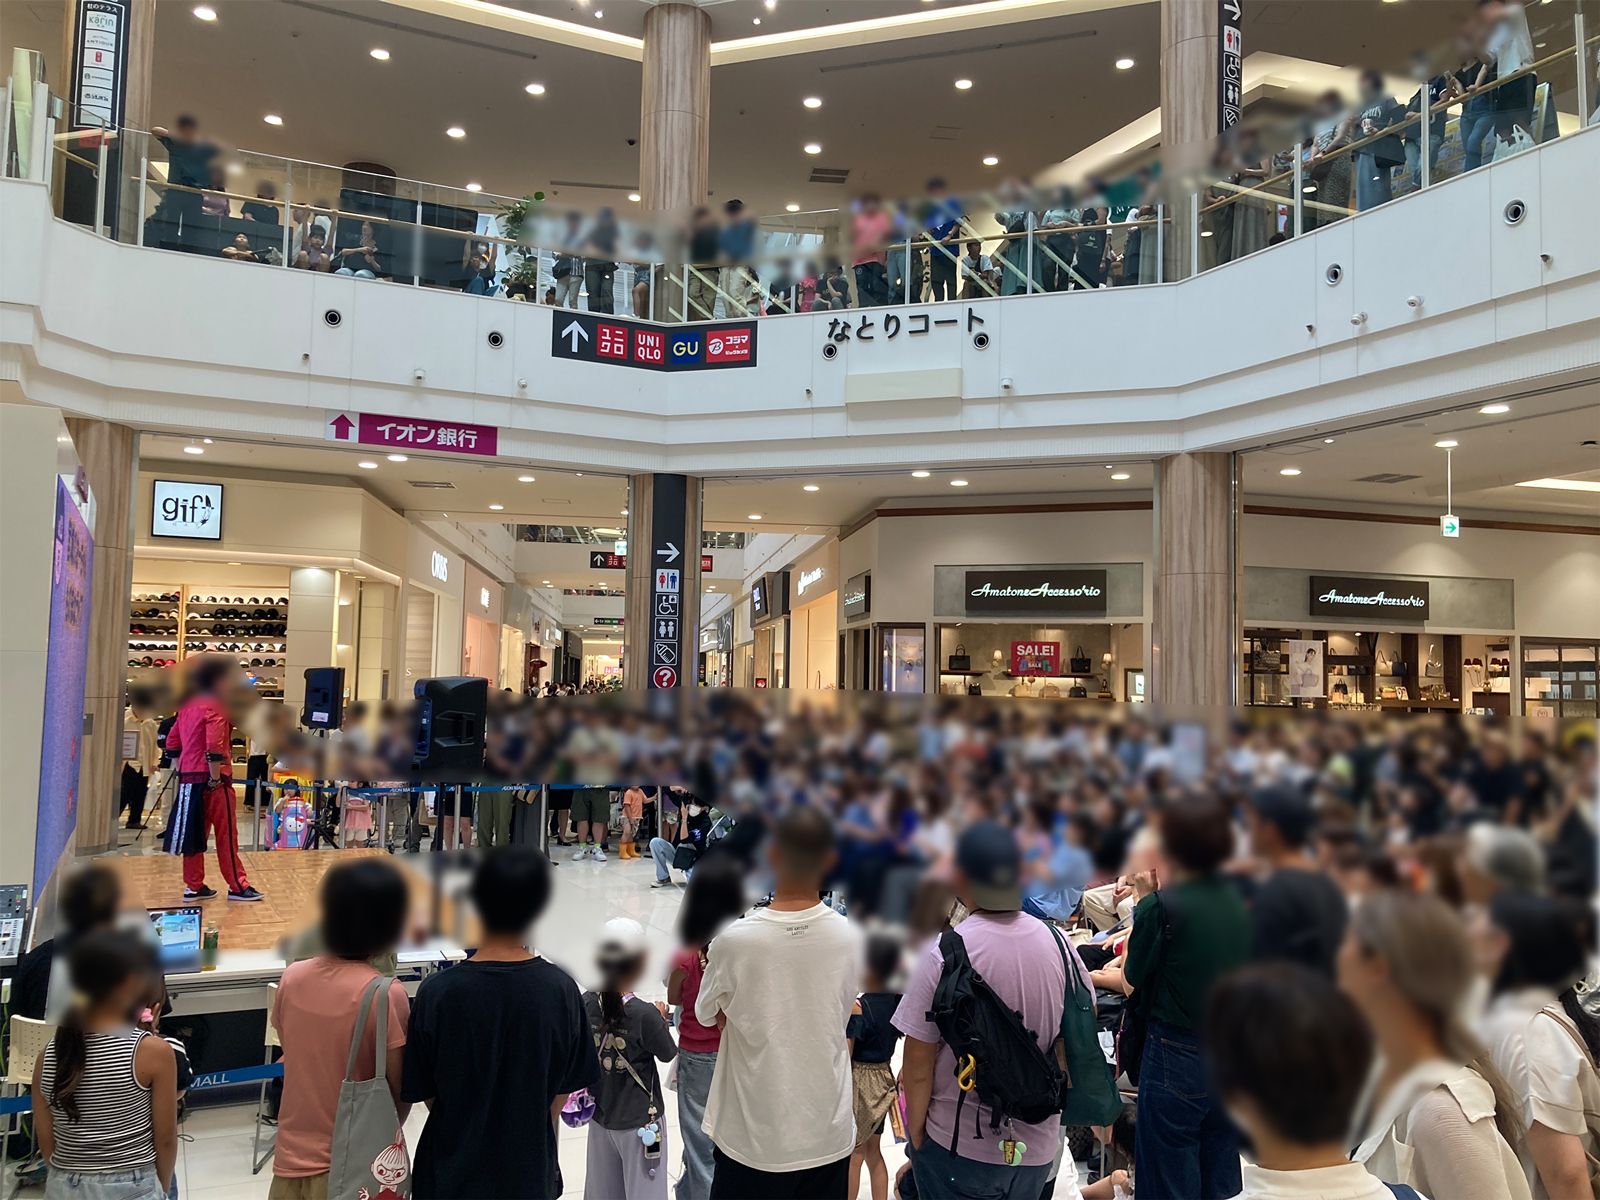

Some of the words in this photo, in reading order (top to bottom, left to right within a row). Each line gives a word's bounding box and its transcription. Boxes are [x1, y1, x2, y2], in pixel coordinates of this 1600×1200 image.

[827, 307, 985, 343] なとりコート
[725, 335, 749, 345] コジマ
[672, 341, 699, 357] GU
[376, 422, 478, 449] イオン銀行
[1016, 644, 1055, 656] SALE!
